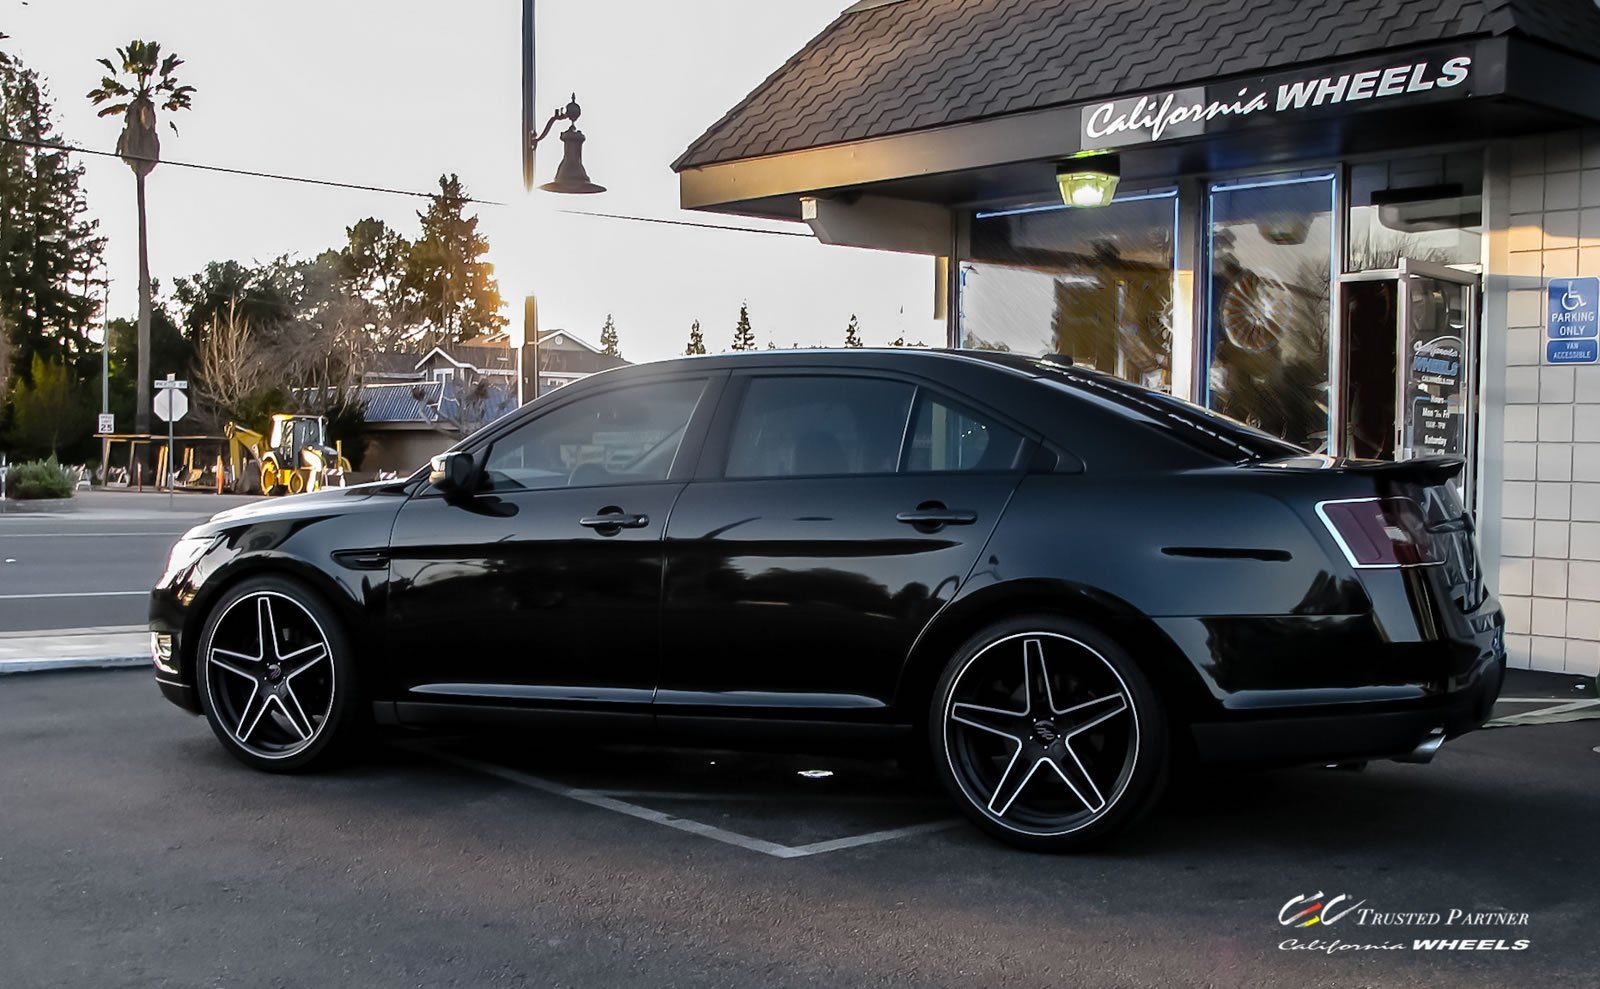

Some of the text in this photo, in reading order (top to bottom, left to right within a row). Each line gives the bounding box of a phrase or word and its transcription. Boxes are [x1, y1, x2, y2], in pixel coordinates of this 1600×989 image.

[1086, 56, 1472, 141] California WHEELS
[1551, 311, 1595, 323] PARKING
[1559, 325, 1586, 336] ONLY
[1566, 342, 1579, 350] VAN
[100, 423, 113, 432] 25
